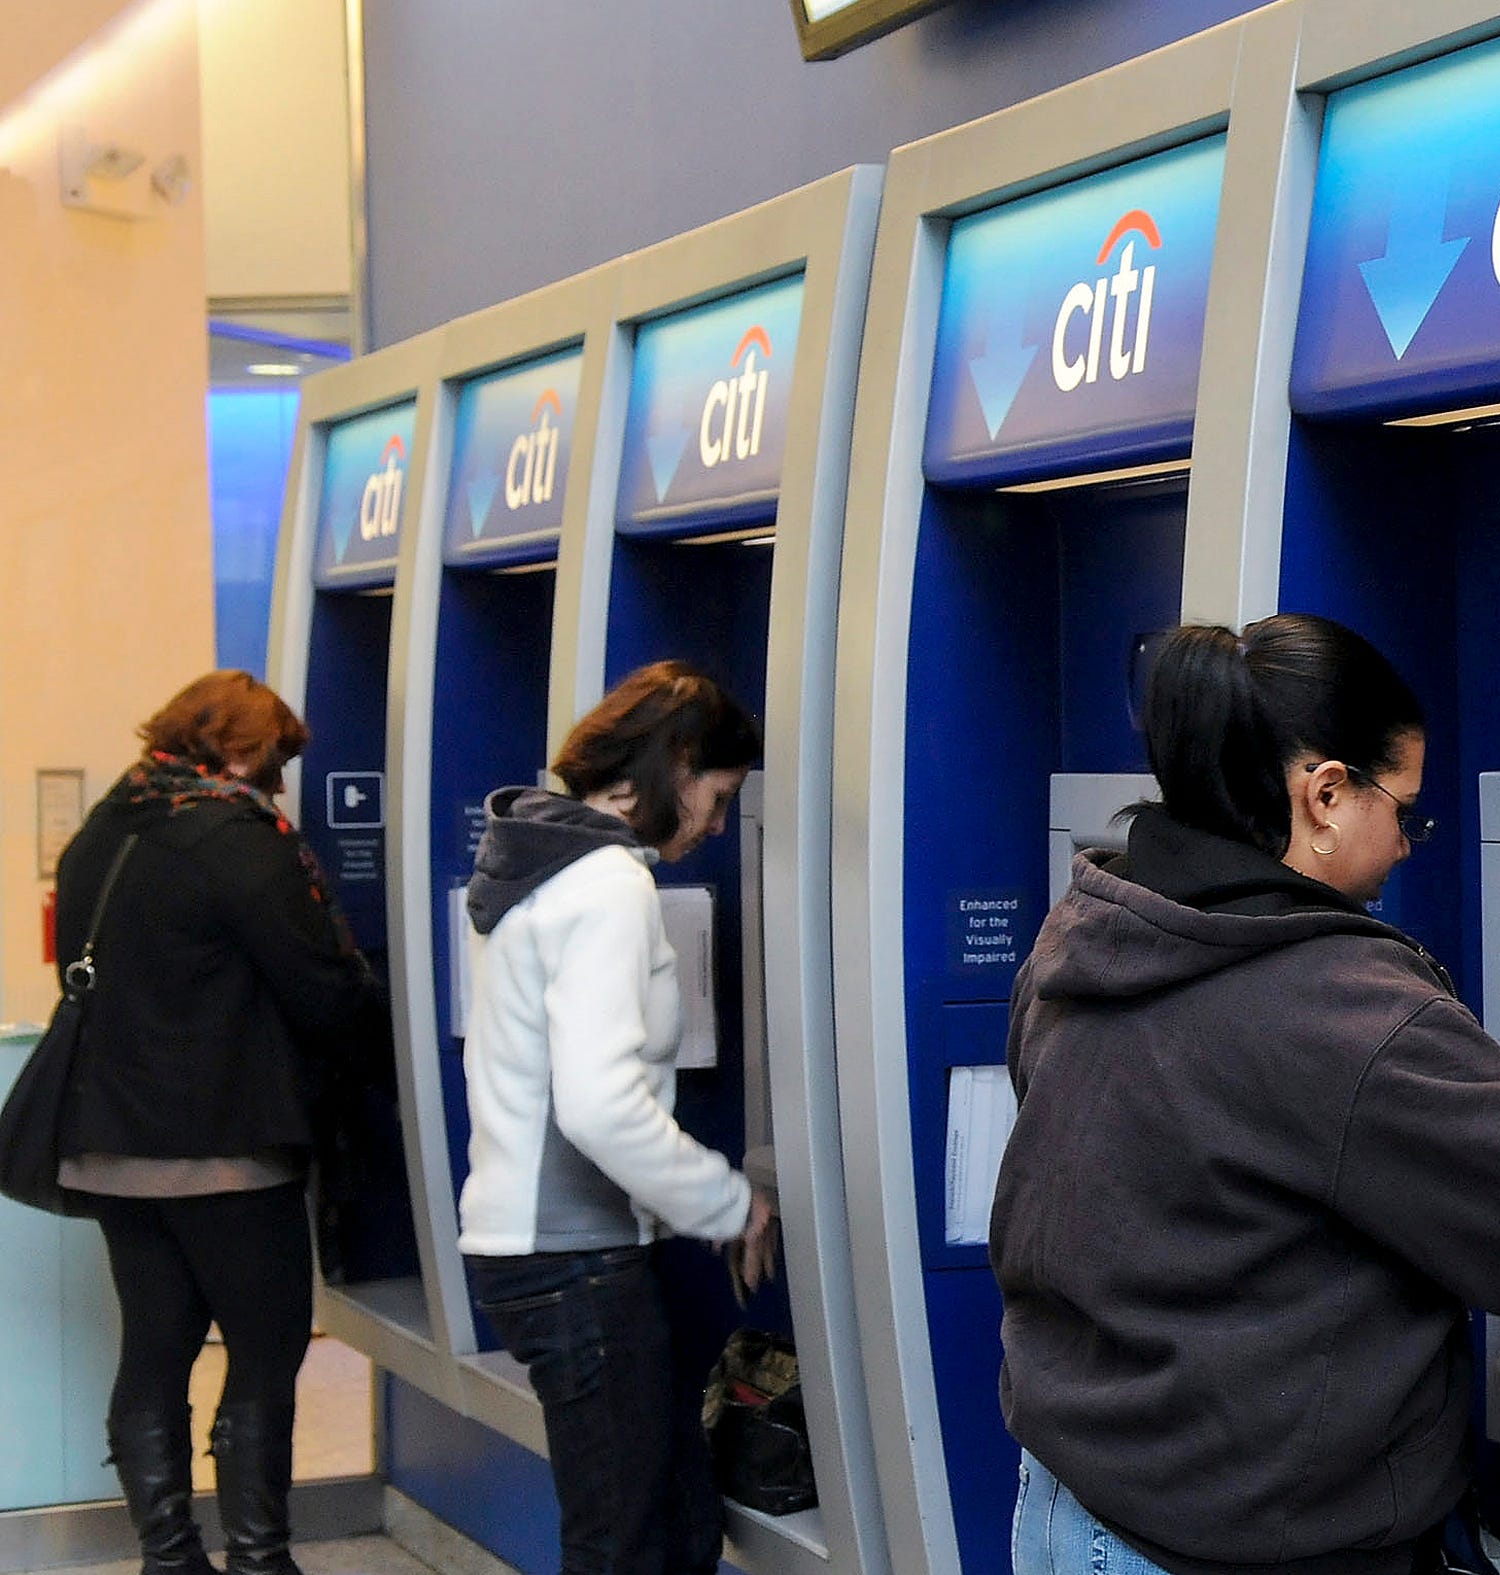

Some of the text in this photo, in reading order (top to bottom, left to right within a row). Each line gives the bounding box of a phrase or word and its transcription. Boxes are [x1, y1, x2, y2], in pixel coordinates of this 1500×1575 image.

[1052, 240, 1156, 393] citi
[698, 350, 770, 468] citi
[505, 409, 561, 510] citi
[359, 456, 405, 541] citi
[959, 899, 1018, 911] Enhanced
[969, 917, 1009, 928] for the
[963, 952, 1016, 965] Impaired
[966, 934, 1013, 946] Visually
